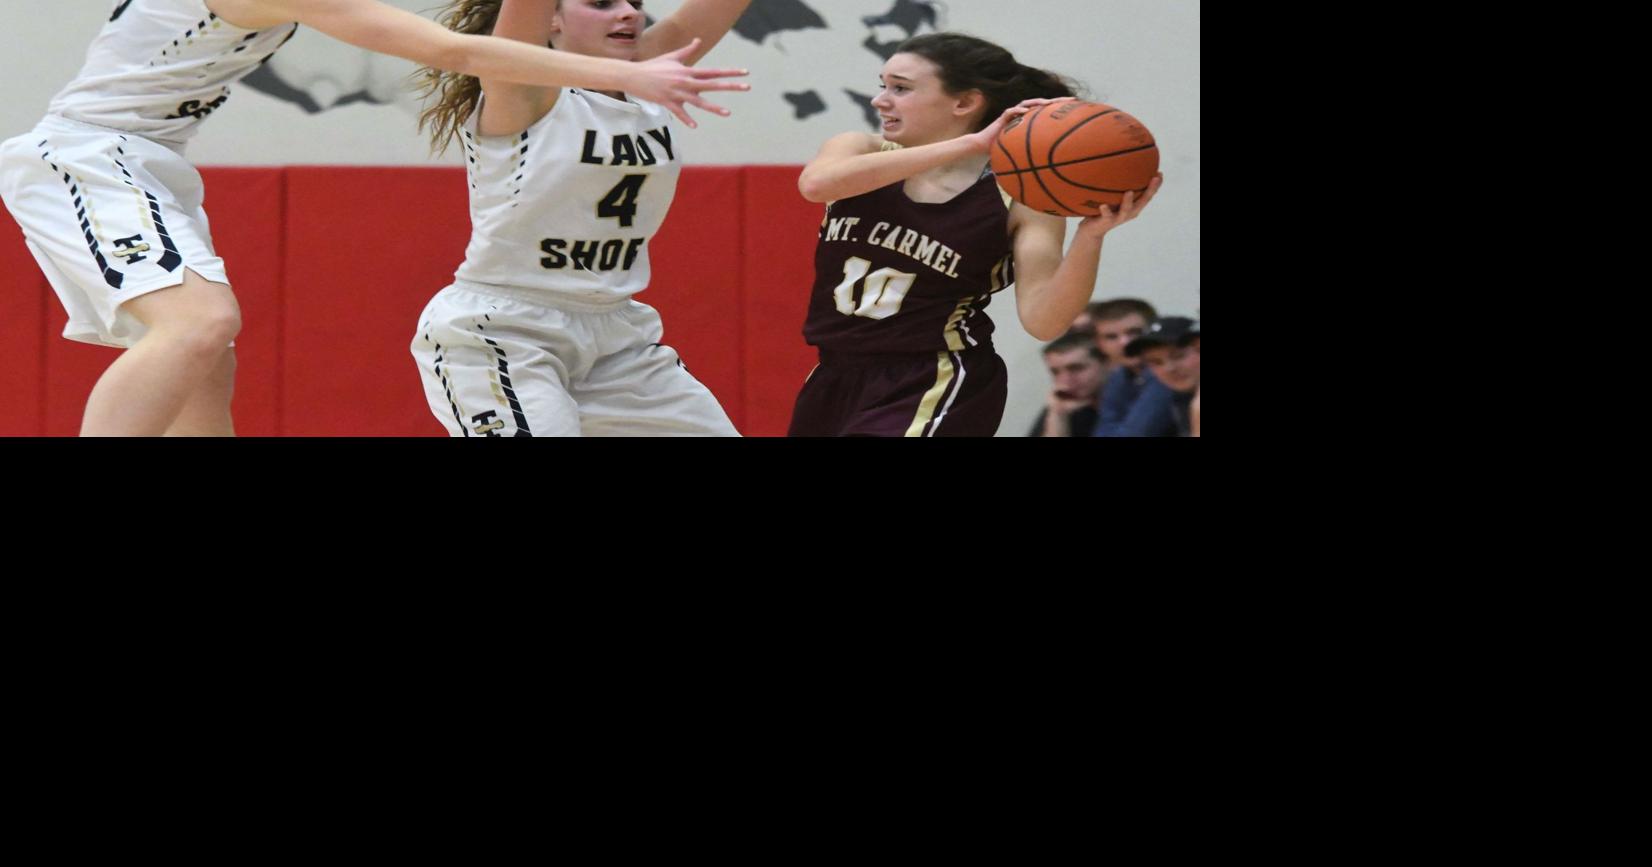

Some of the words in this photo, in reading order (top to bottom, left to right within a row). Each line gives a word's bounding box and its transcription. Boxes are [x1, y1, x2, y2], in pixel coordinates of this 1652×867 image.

[580, 125, 675, 166] LADY
[595, 172, 650, 229] 4
[825, 216, 861, 243] MT.
[867, 221, 962, 279] CARMEL
[833, 255, 917, 320] 10
